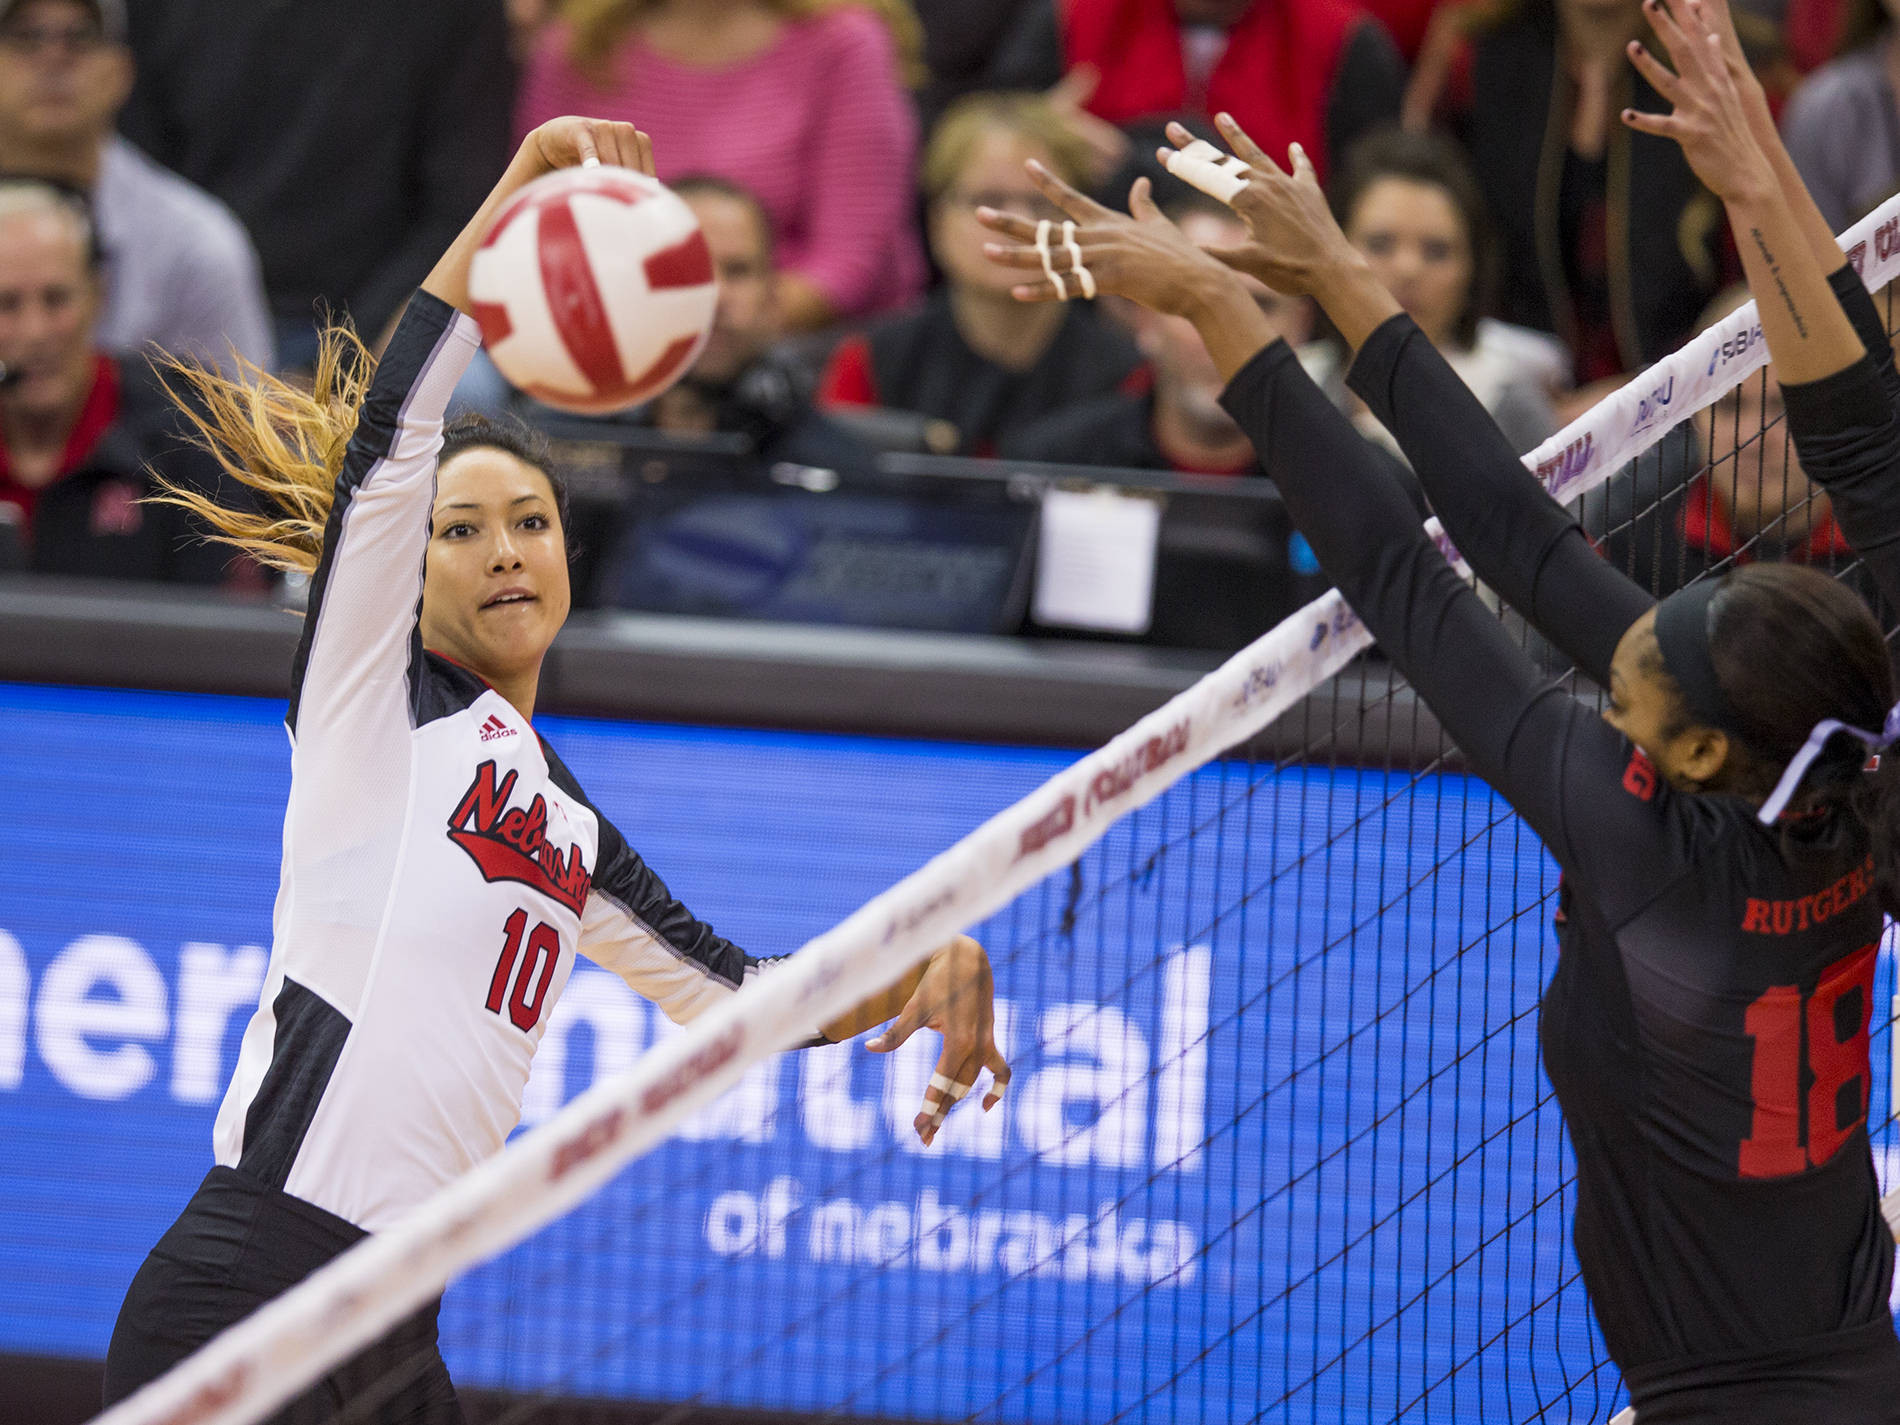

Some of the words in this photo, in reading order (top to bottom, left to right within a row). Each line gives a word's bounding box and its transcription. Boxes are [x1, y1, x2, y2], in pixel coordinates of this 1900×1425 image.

[447, 759, 592, 910] Nebaska
[485, 907, 561, 1033] 10
[1738, 943, 1876, 1178] 18
[702, 1175, 798, 1262] of
[808, 1184, 1200, 1289] nebraska
